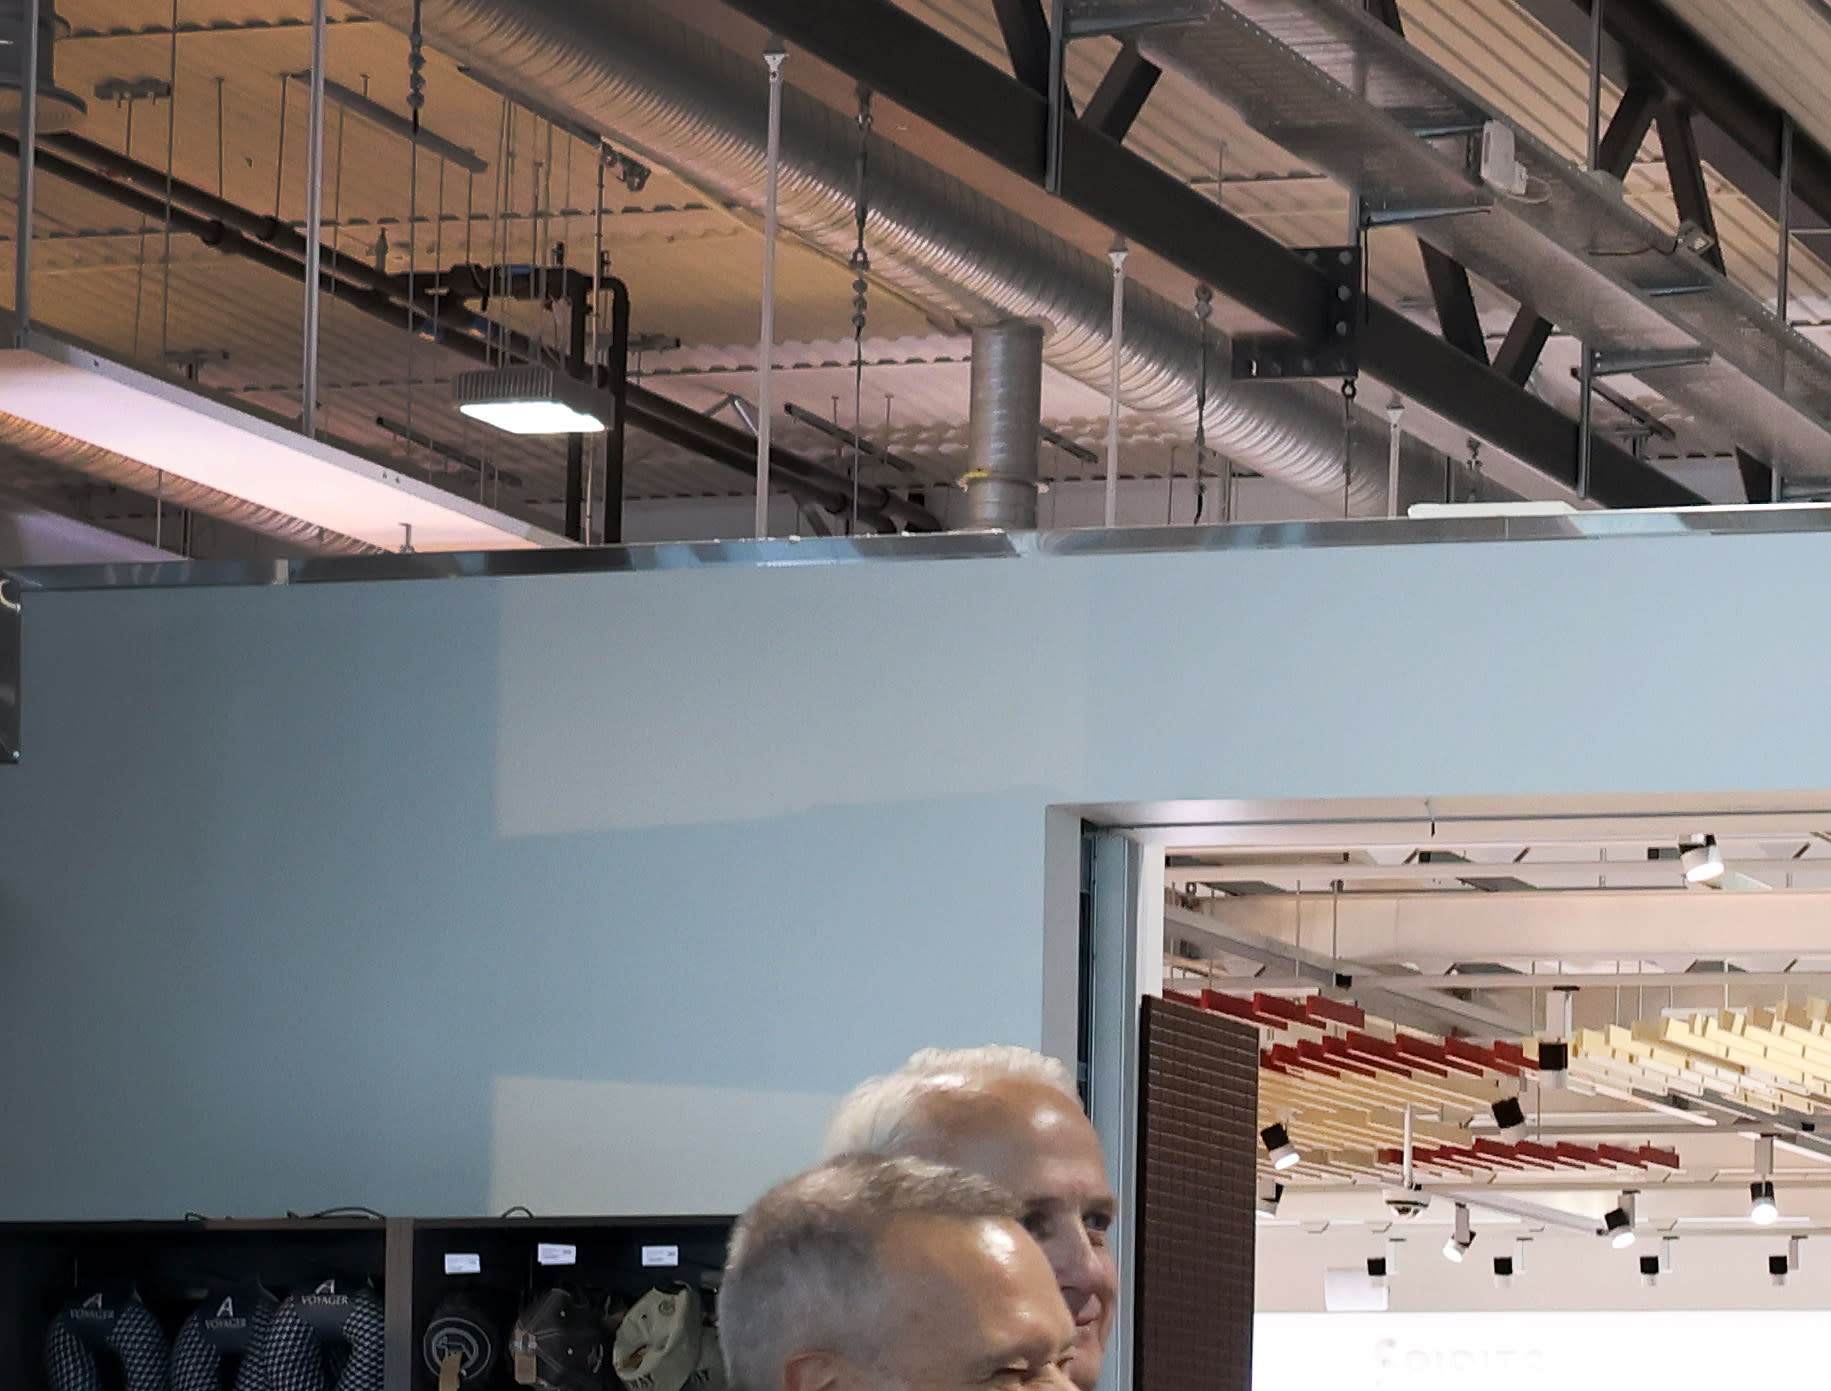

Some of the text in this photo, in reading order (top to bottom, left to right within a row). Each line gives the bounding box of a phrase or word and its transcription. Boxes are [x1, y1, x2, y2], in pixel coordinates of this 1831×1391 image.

[300, 1295, 348, 1306] VOYAGER
[69, 1309, 115, 1320] VOYAGER
[204, 1316, 247, 1329] VOYAGER
